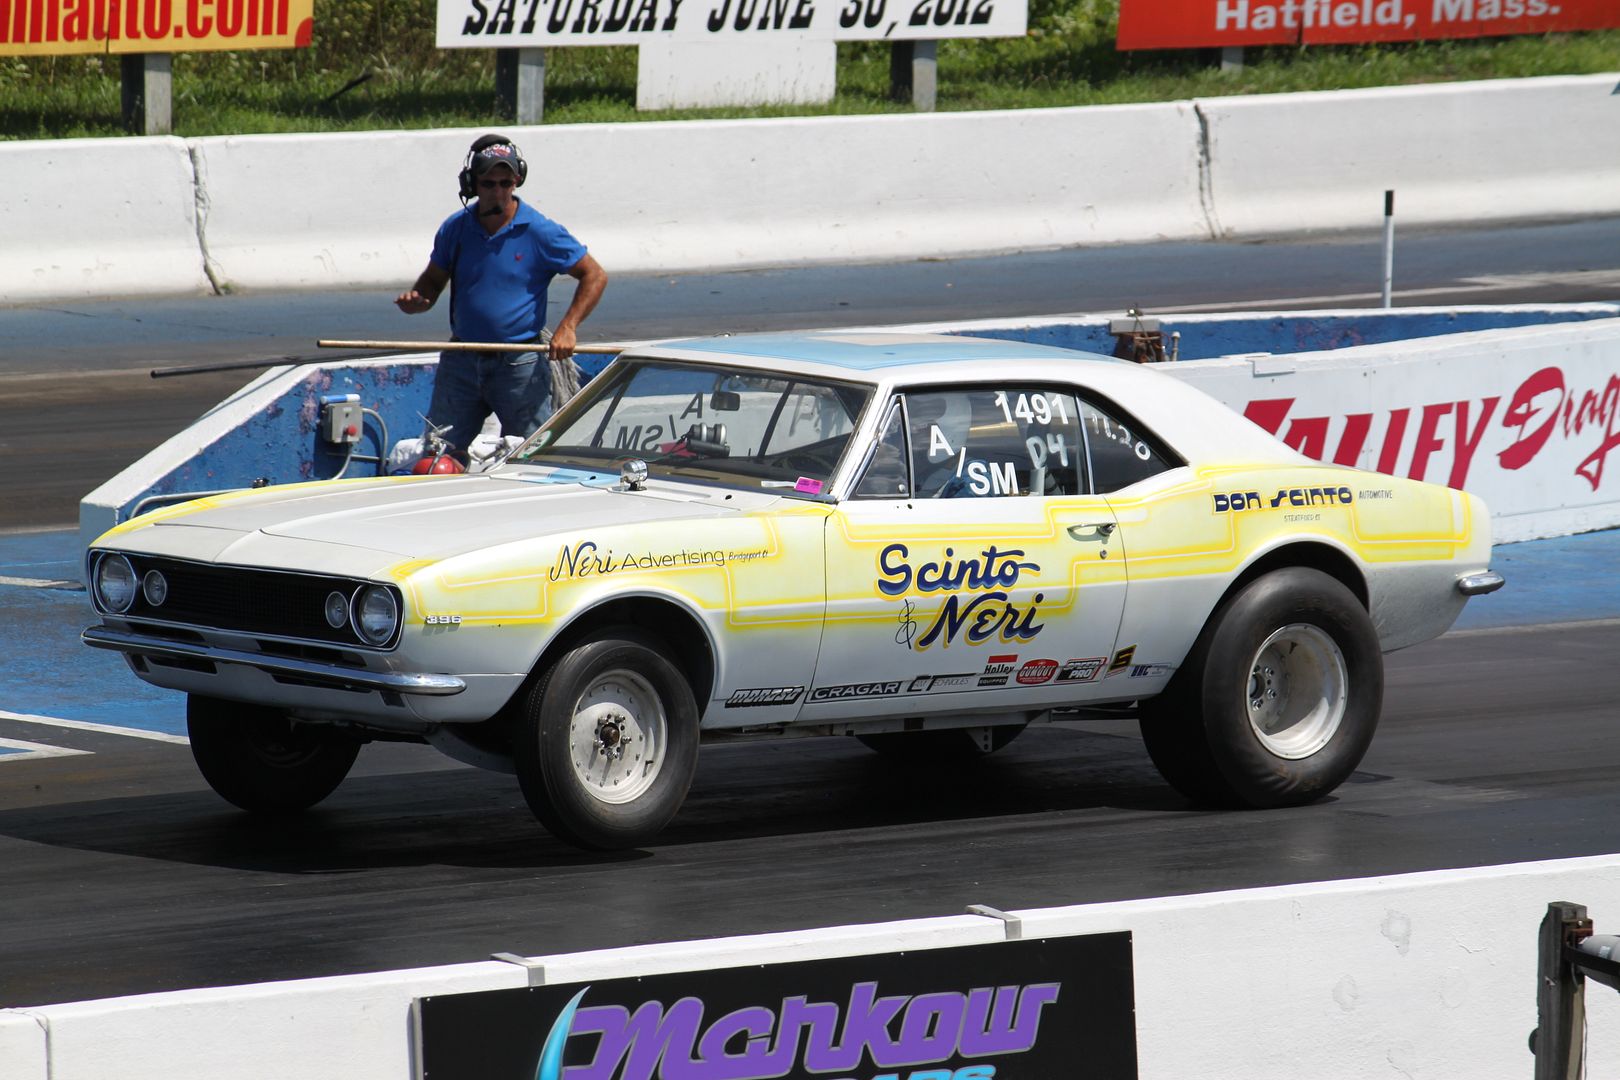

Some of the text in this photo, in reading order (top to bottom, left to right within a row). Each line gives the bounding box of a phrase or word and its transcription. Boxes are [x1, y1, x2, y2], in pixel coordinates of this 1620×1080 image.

[461, 0, 682, 35] SATURDAY
[706, 0, 816, 32] JUNE
[1215, 0, 1562, 30] Hatfield, Mass.
[994, 390, 1069, 425] 1491
[1025, 432, 1069, 470] D4
[1213, 486, 1393, 512] DON SCINTO AUTOMOTIVE
[549, 541, 618, 581] Neri
[621, 549, 726, 572] Advertising
[877, 543, 1041, 596] Scinto
[425, 614, 462, 625] 396
[918, 591, 1045, 648] Neri
[984, 664, 1015, 675] Holley
[1020, 665, 1057, 677] GUMOUT
[1068, 669, 1092, 679] PRO
[814, 682, 899, 699] CRAGAR
